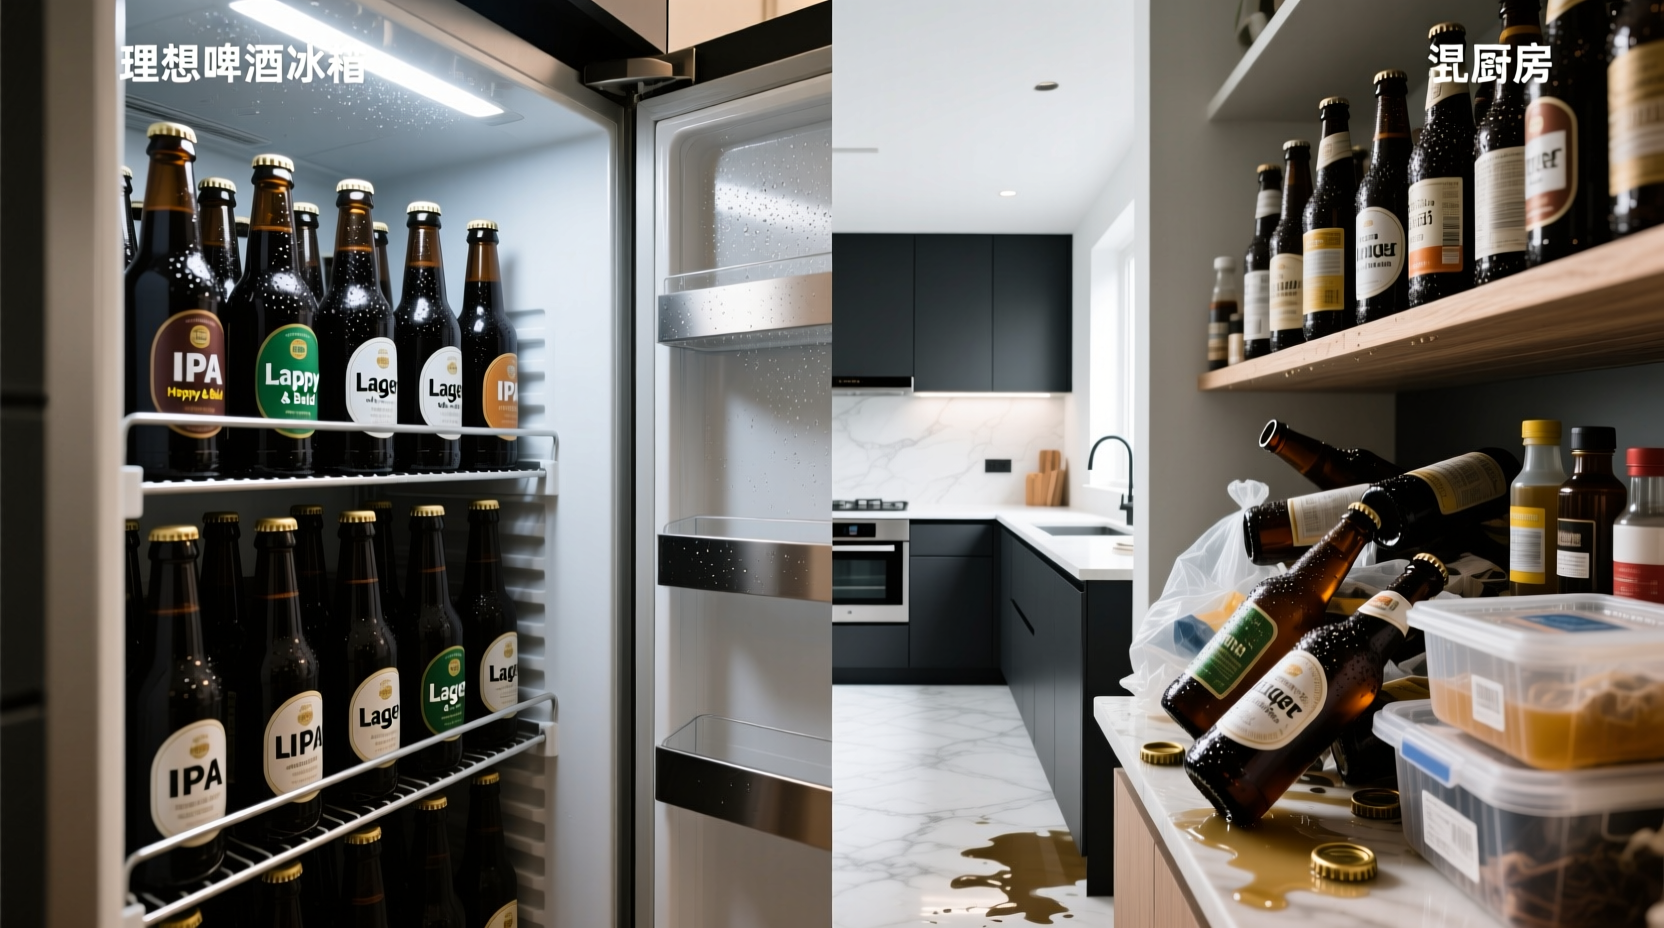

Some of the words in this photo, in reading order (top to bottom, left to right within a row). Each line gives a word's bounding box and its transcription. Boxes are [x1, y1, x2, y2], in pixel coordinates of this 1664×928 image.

[173, 352, 223, 385] IPA
[265, 362, 320, 393] Lappy
[275, 725, 323, 760] LIPA
[169, 757, 223, 799] IPA
